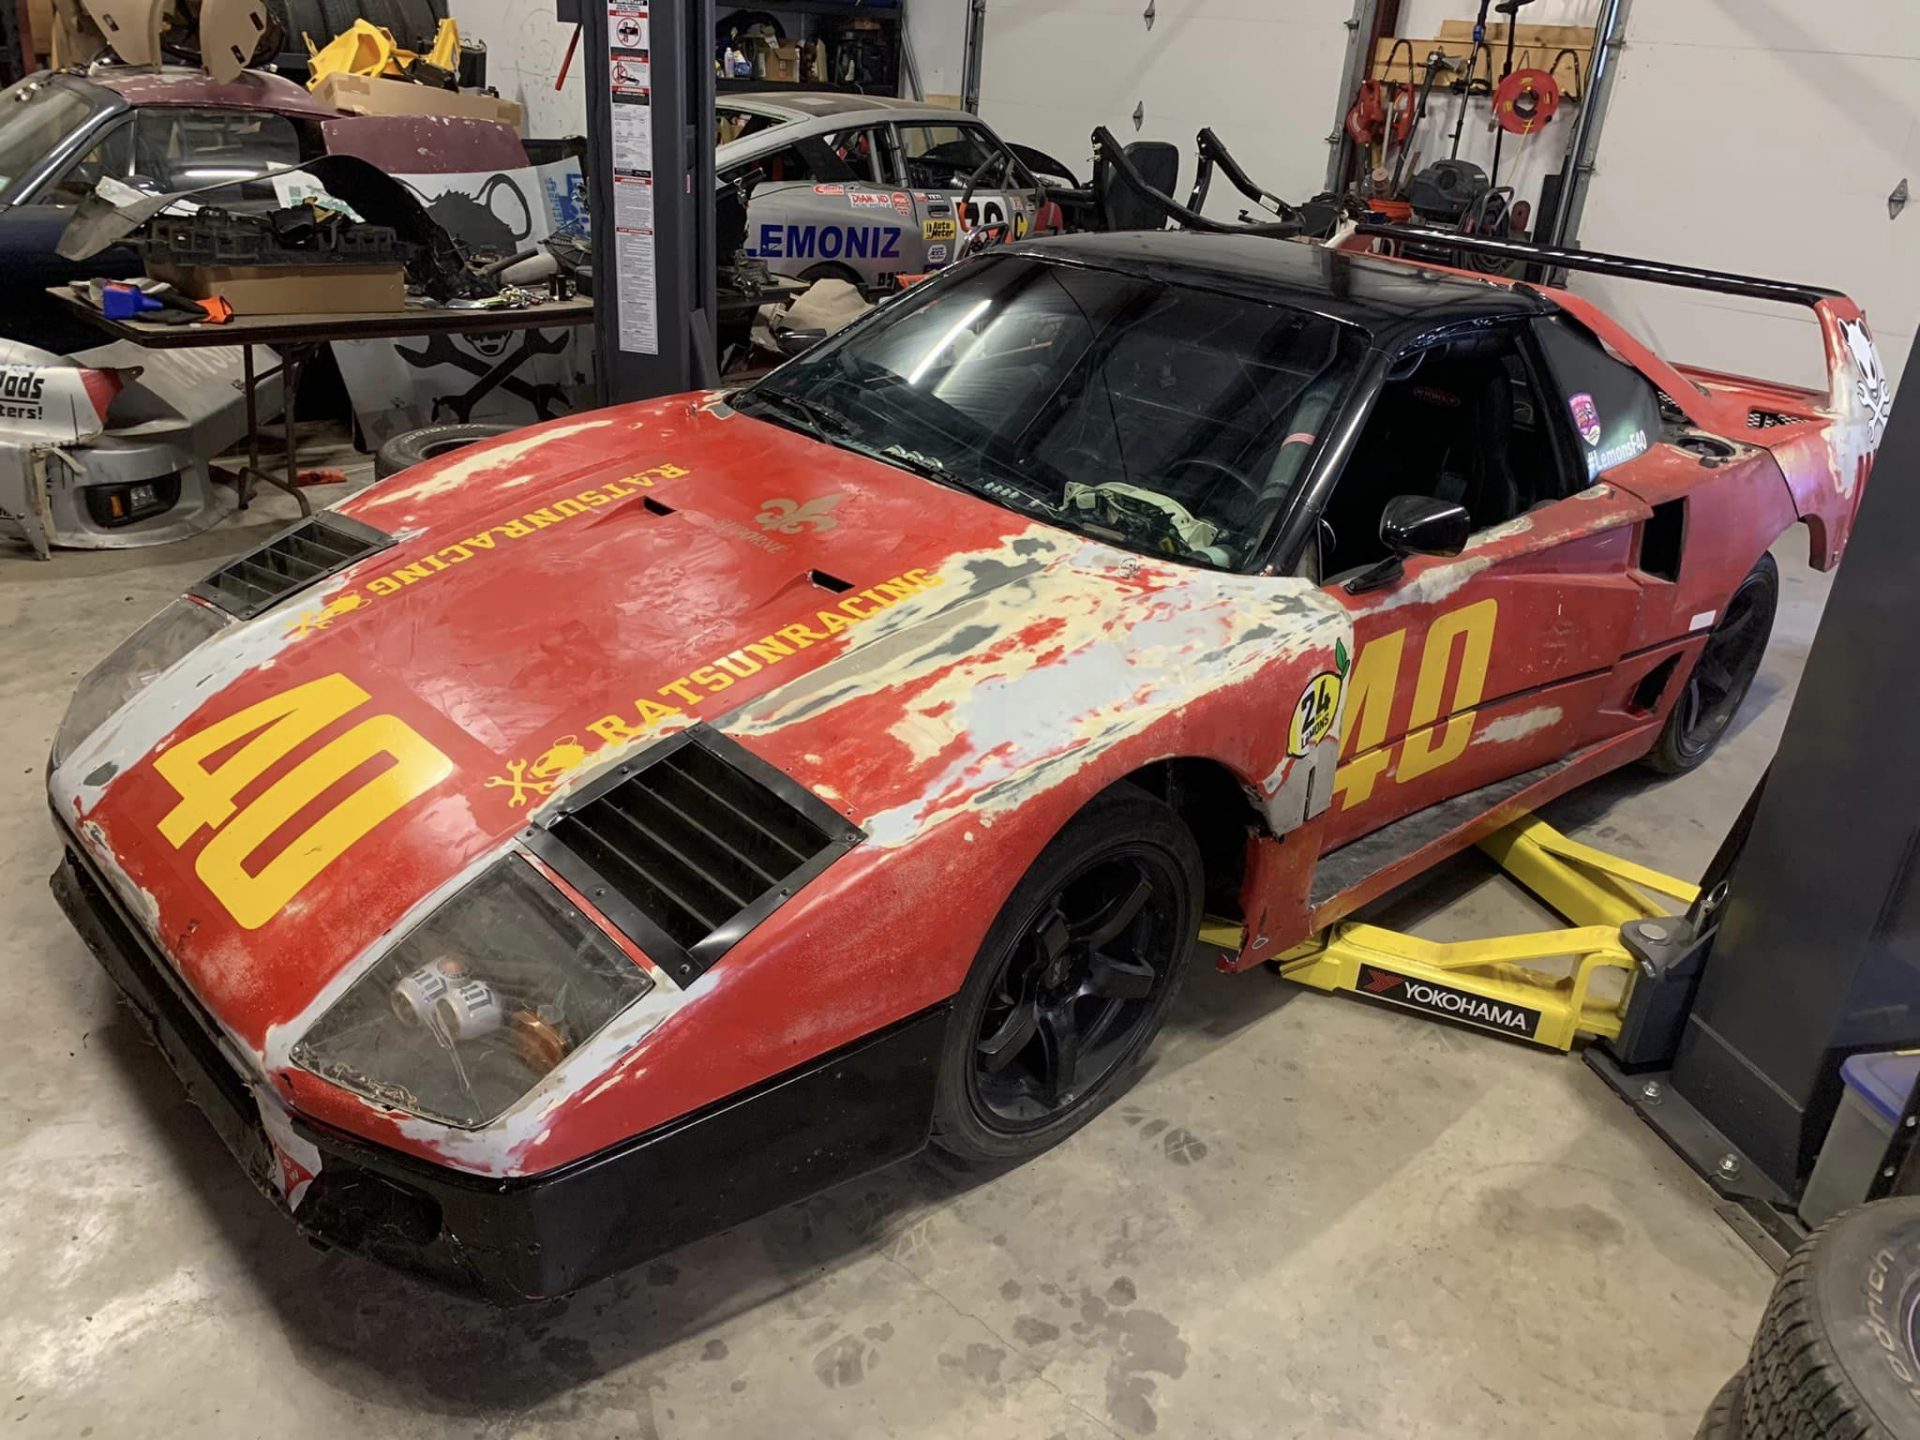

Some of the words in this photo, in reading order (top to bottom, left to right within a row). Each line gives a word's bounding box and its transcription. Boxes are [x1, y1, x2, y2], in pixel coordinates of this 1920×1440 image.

[746, 224, 901, 258] EMONIZ
[1587, 429, 1648, 470] #LemonsF40
[366, 463, 690, 597] RATSUNRACING
[586, 567, 944, 747] RATSUNRACING
[1301, 678, 1331, 735] 24
[1301, 711, 1330, 750] LEMONS
[1331, 598, 1498, 812] 40
[152, 672, 454, 931] 40
[1404, 981, 1527, 1031] YOKOHAMA
